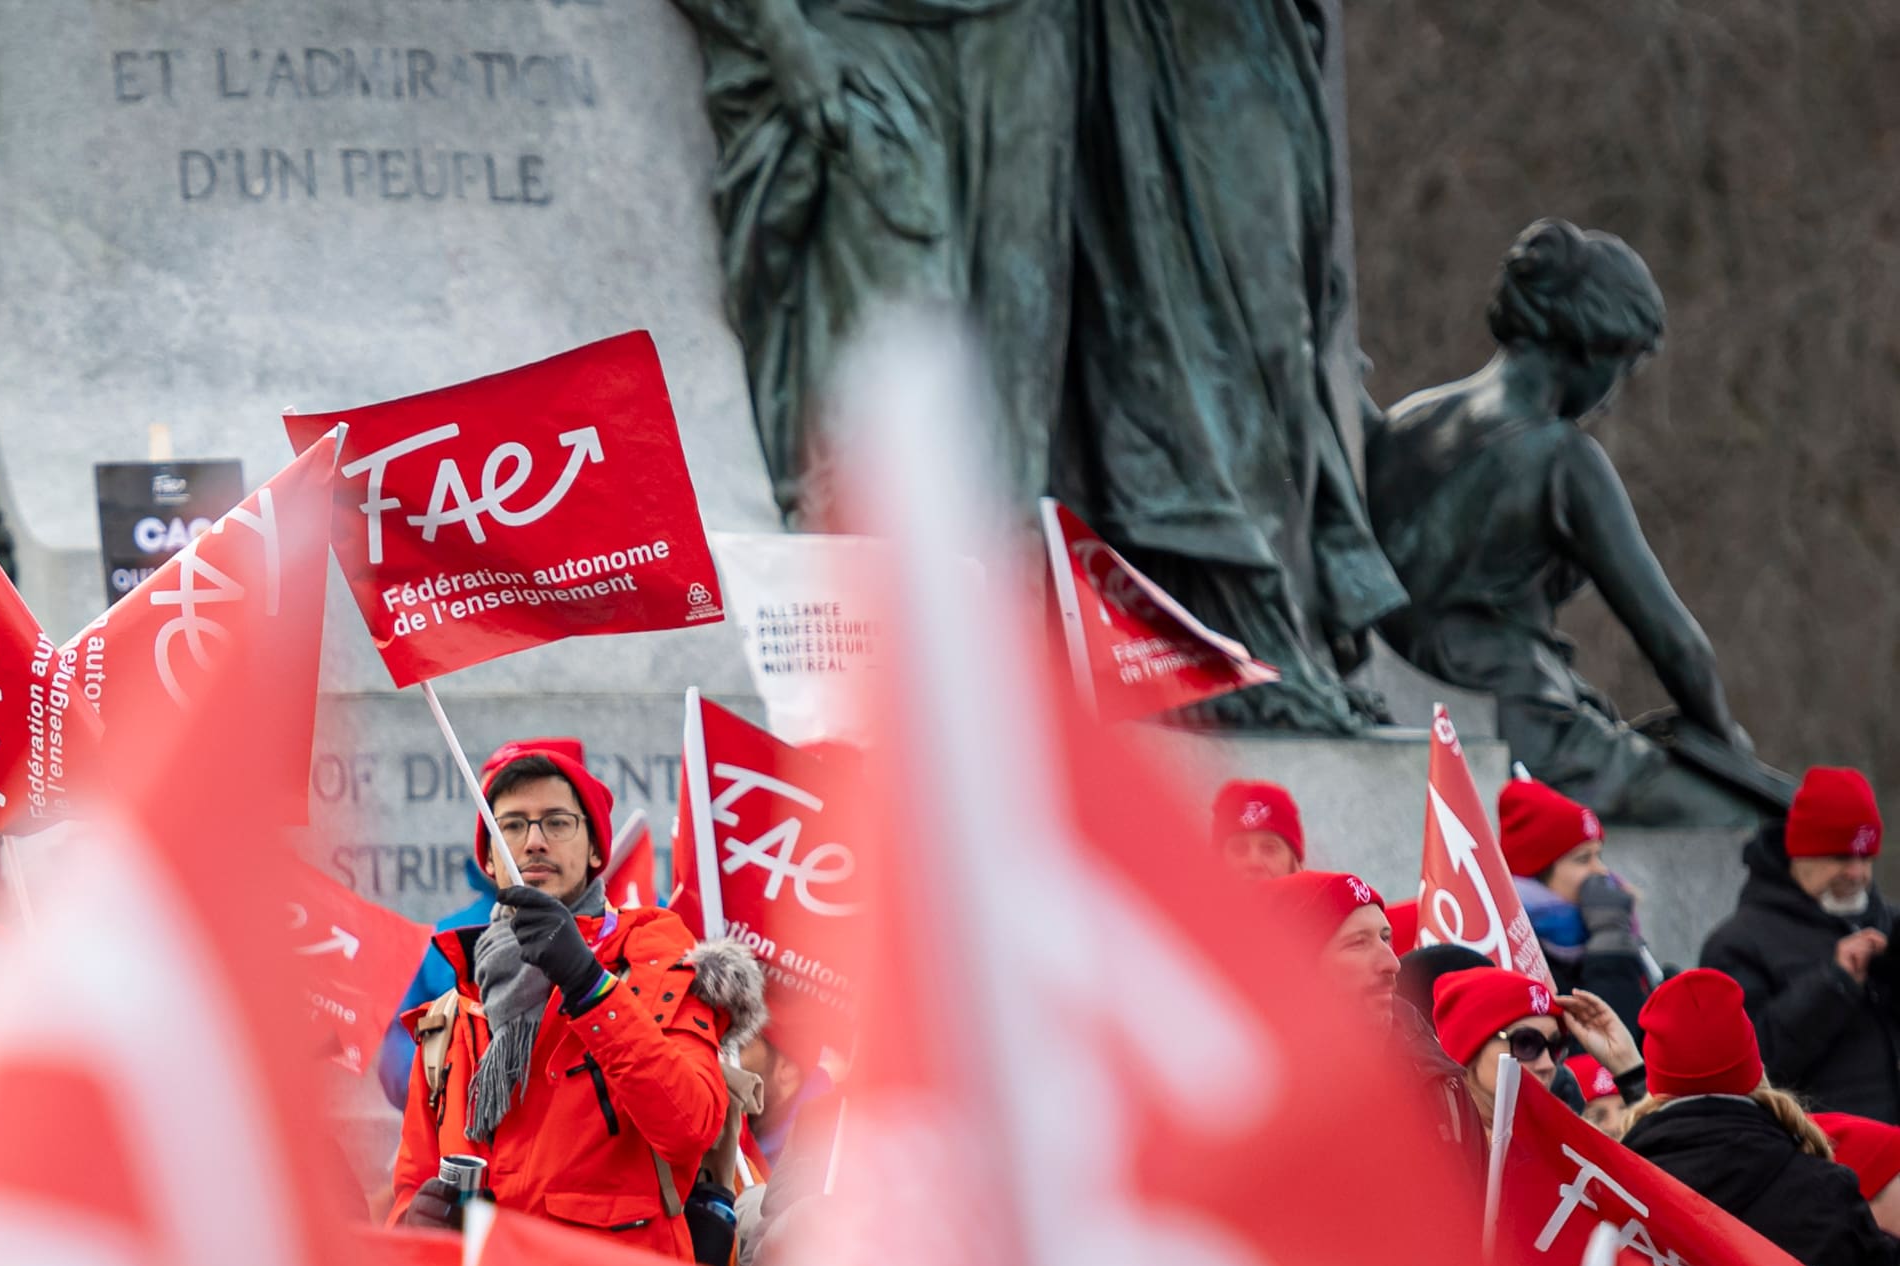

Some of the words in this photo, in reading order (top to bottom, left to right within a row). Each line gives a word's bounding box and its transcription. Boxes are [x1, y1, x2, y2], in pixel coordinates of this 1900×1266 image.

[113, 48, 182, 101] ET
[179, 148, 317, 200] D'UN
[382, 567, 528, 613] Fédération
[533, 539, 670, 585] autonome
[393, 612, 427, 637] de
